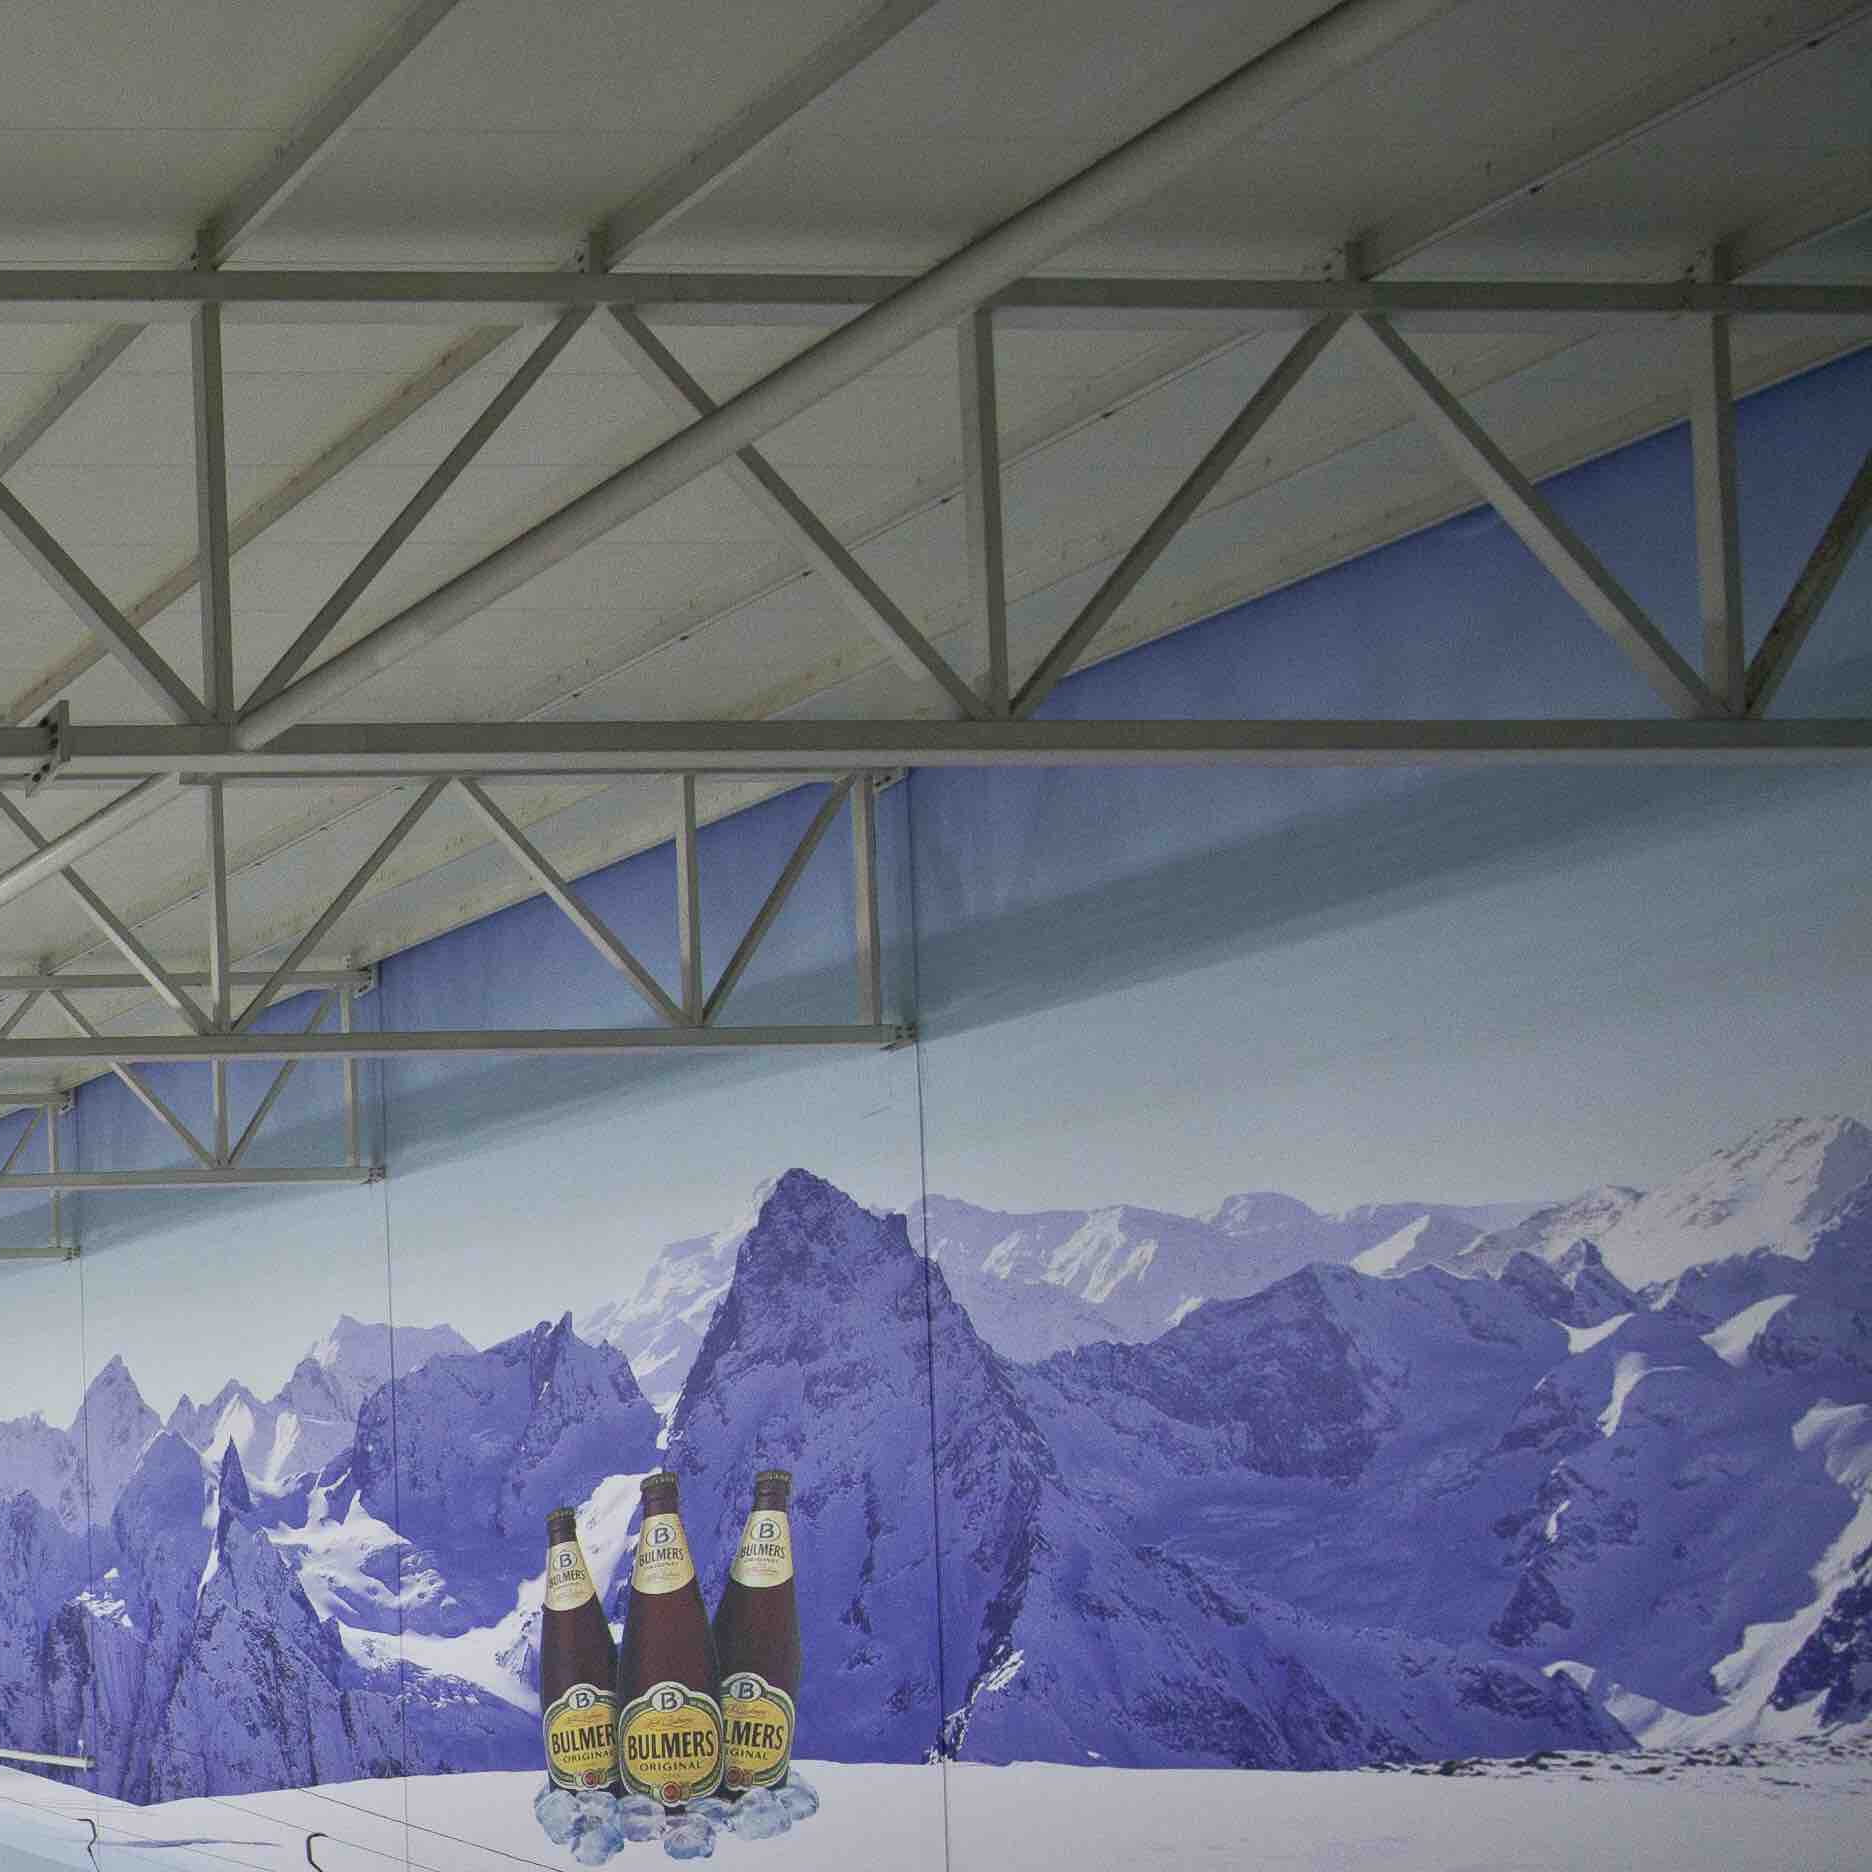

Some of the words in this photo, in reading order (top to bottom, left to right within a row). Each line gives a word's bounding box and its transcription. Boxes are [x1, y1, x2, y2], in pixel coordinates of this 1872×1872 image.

[638, 1548, 683, 1567] BULMERS
[740, 1543, 785, 1559] BULMERS
[548, 1569, 586, 1588] BULMERS
[627, 1730, 715, 1761] BULMERS
[639, 1760, 703, 1773] ORIGINAL
